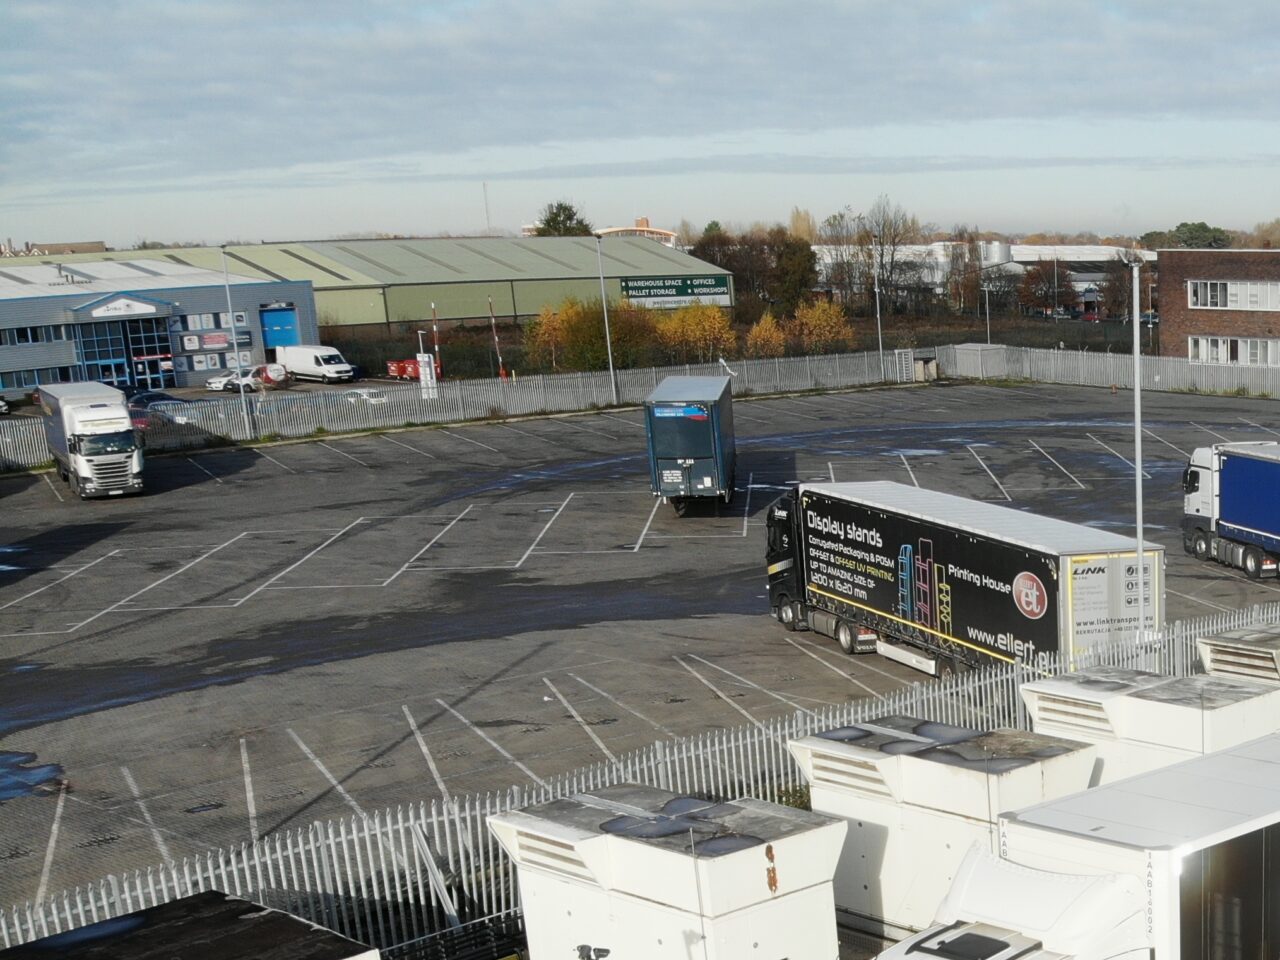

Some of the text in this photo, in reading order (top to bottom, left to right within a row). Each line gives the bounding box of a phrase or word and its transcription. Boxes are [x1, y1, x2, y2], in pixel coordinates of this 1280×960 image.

[807, 510, 883, 548] Display stands
[809, 535, 838, 551] Corrugated
[838, 543, 870, 562] Packaging
[810, 560, 819, 569] UP
[811, 571, 828, 587] 1200
[834, 580, 853, 595] 1620
[854, 588, 868, 600] mm
[948, 564, 1012, 594] Printing House
[1076, 616, 1153, 627] www.linktranspor.eu
